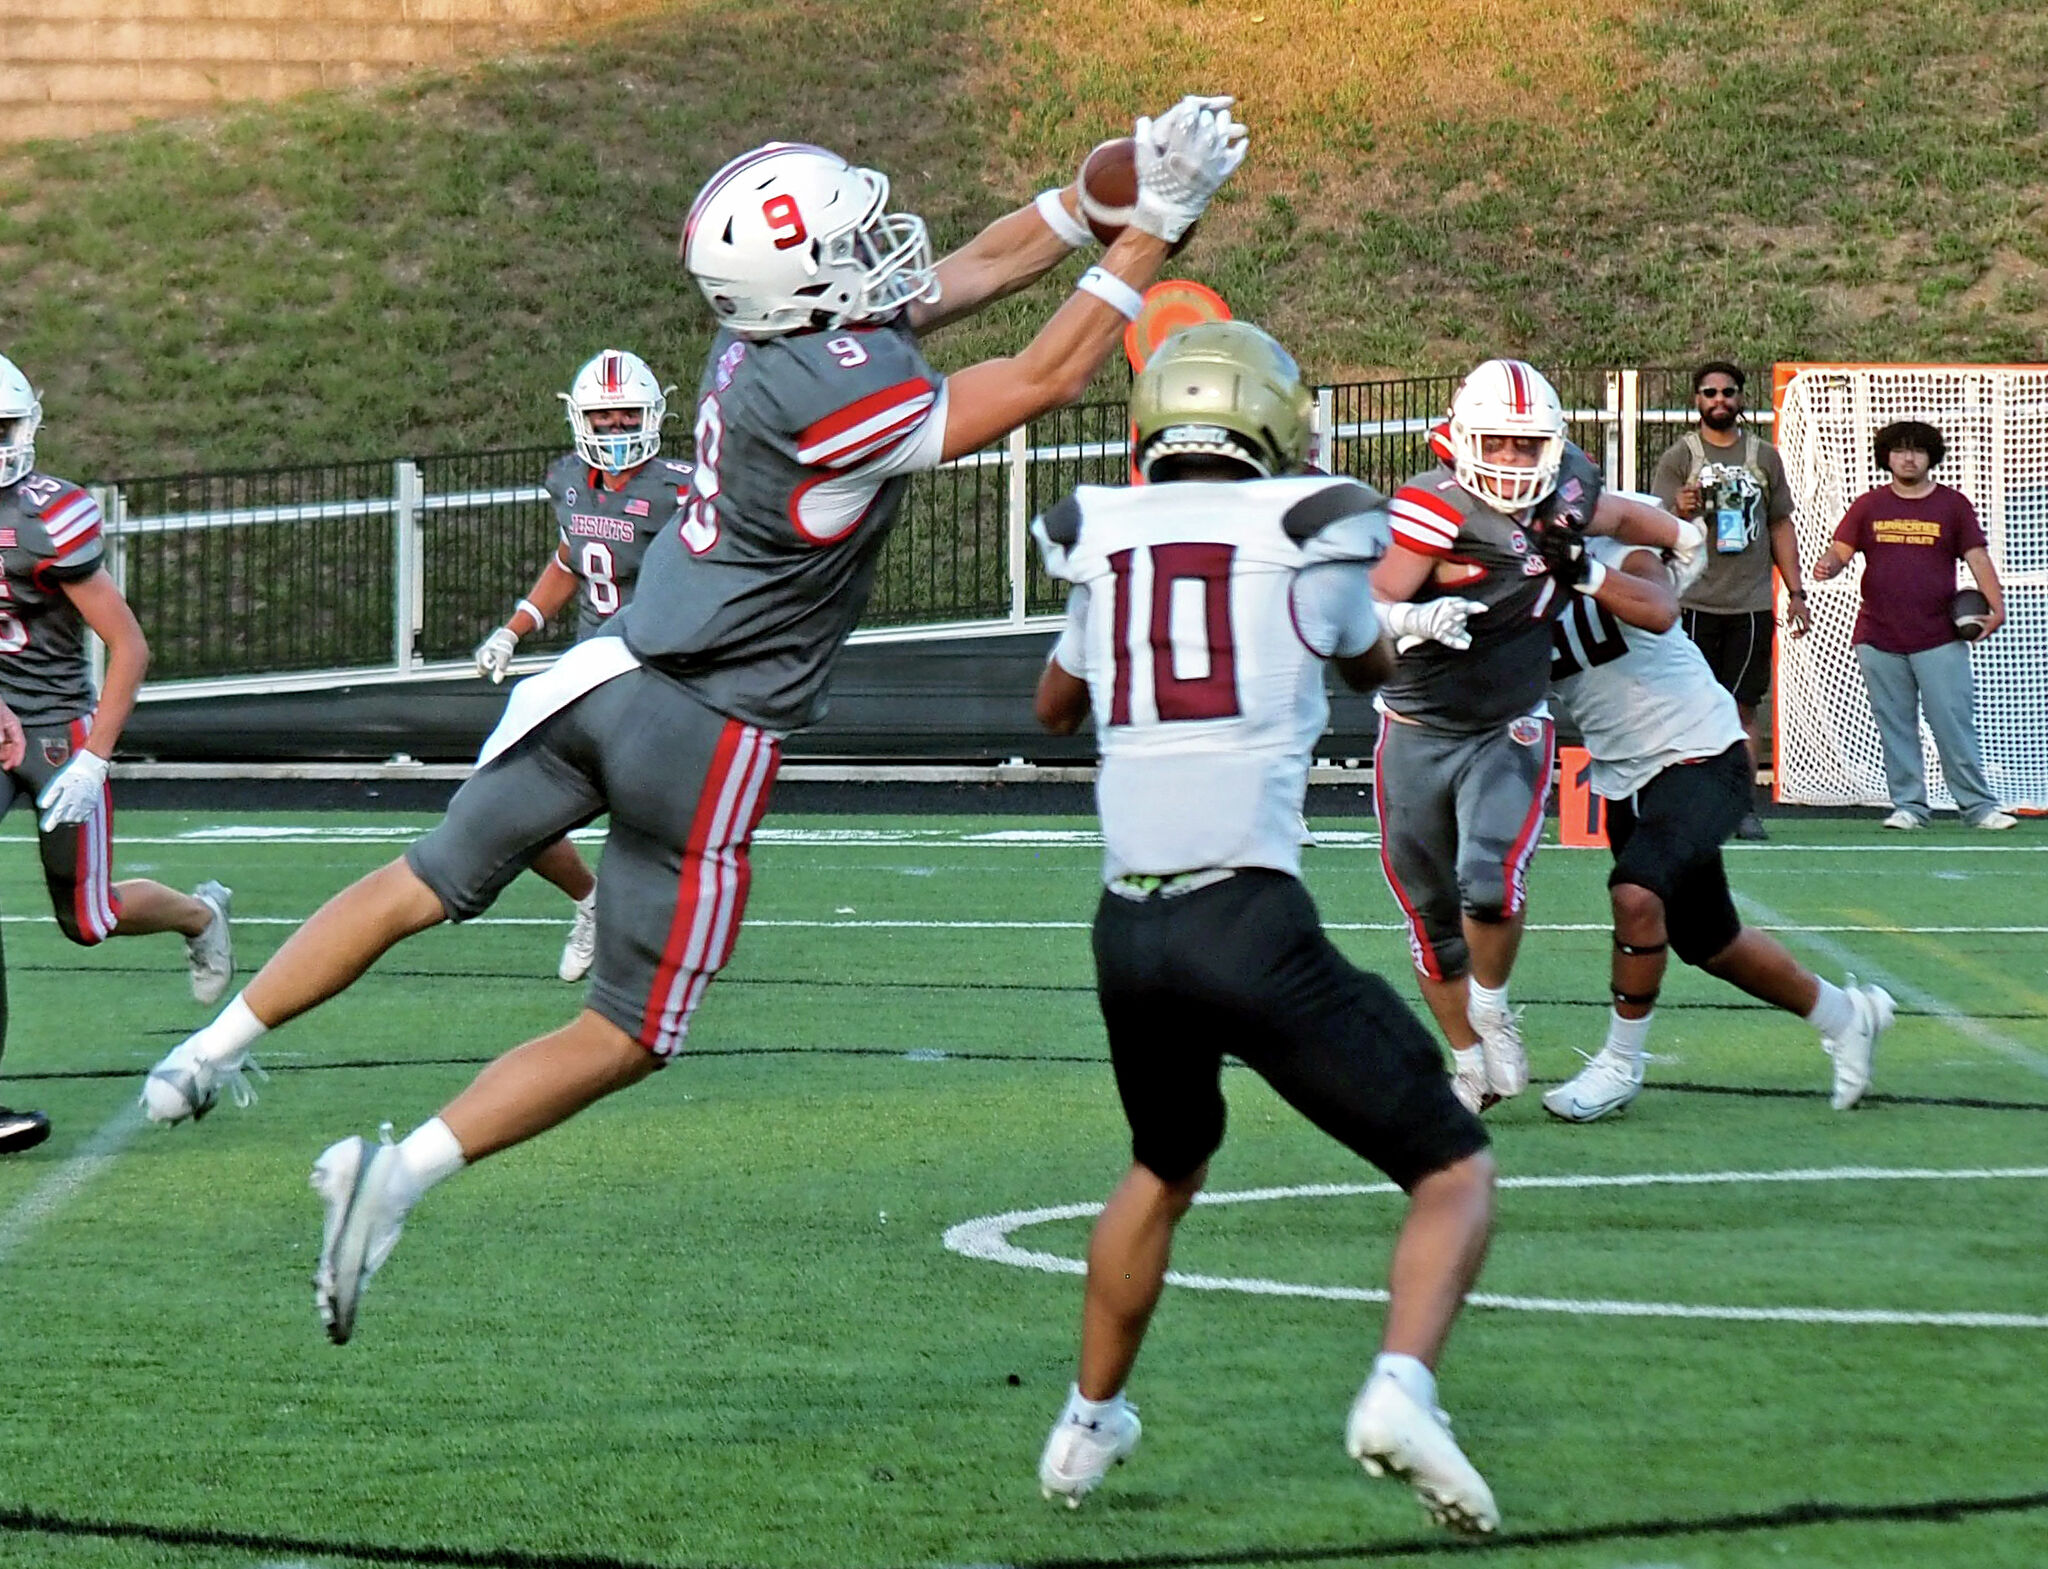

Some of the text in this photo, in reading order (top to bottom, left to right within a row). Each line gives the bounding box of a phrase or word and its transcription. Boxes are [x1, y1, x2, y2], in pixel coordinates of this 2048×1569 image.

[826, 336, 870, 368] 9
[568, 513, 636, 543] JESUITS
[582, 539, 621, 616] 8
[1107, 541, 1244, 727] 10
